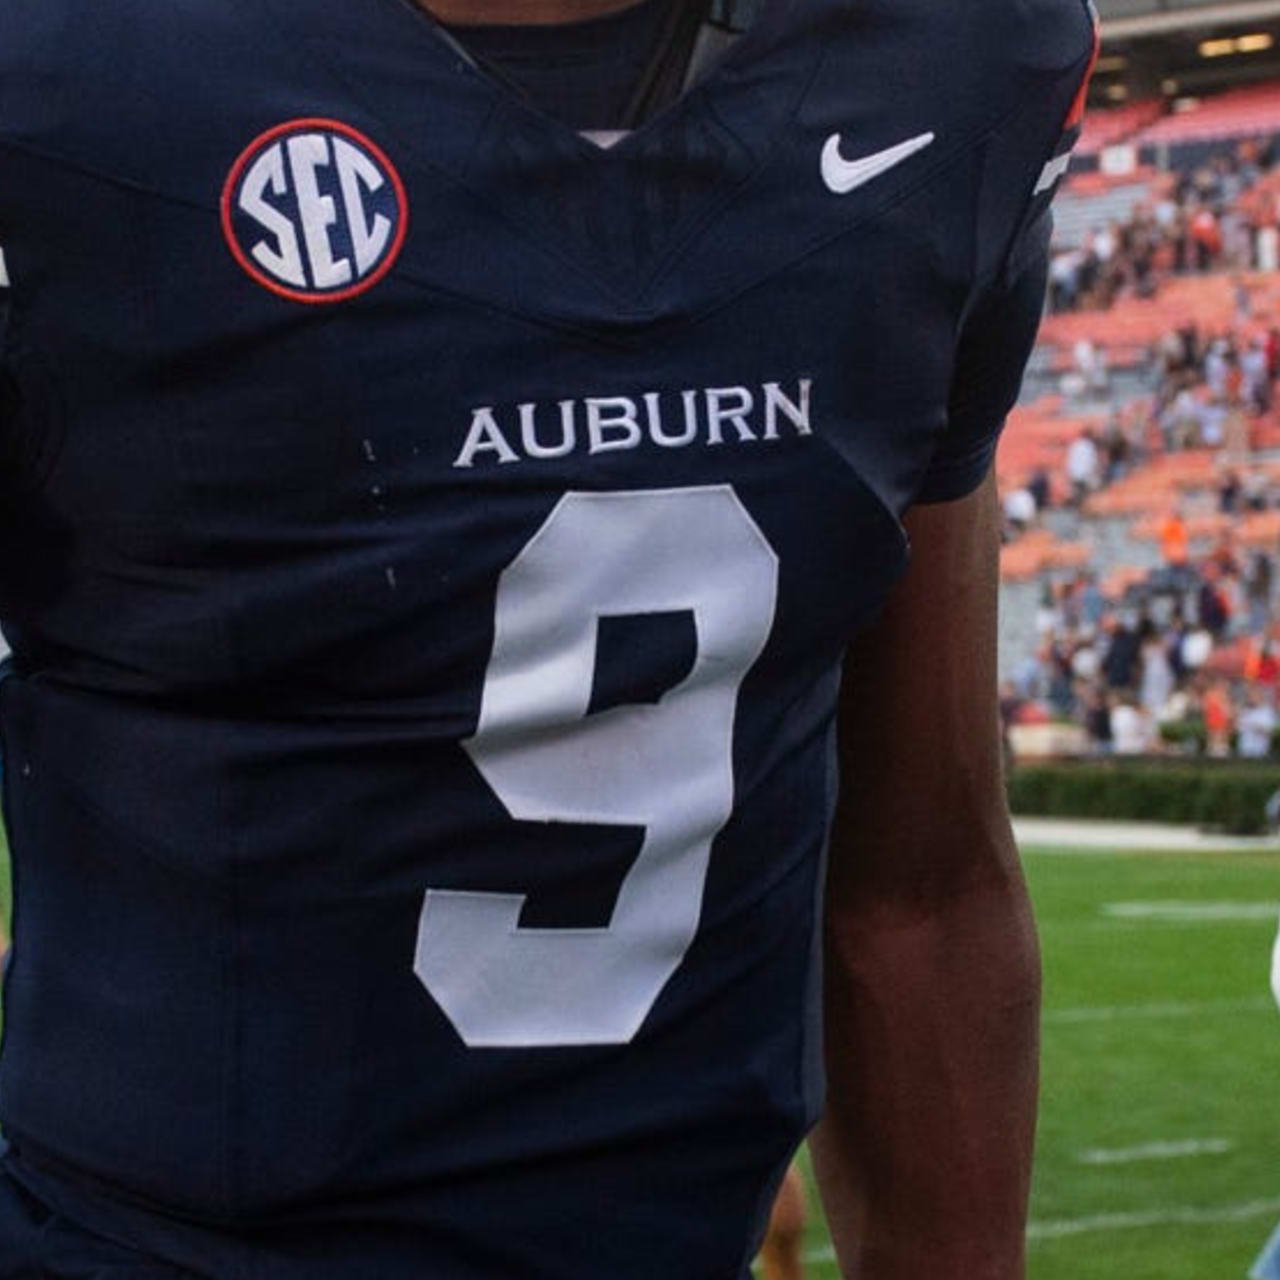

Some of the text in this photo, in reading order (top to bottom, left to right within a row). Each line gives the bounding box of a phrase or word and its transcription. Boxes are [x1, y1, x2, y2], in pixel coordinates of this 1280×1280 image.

[238, 133, 392, 289] SEC
[452, 378, 815, 467] AUBURN
[413, 483, 780, 1048] 9
